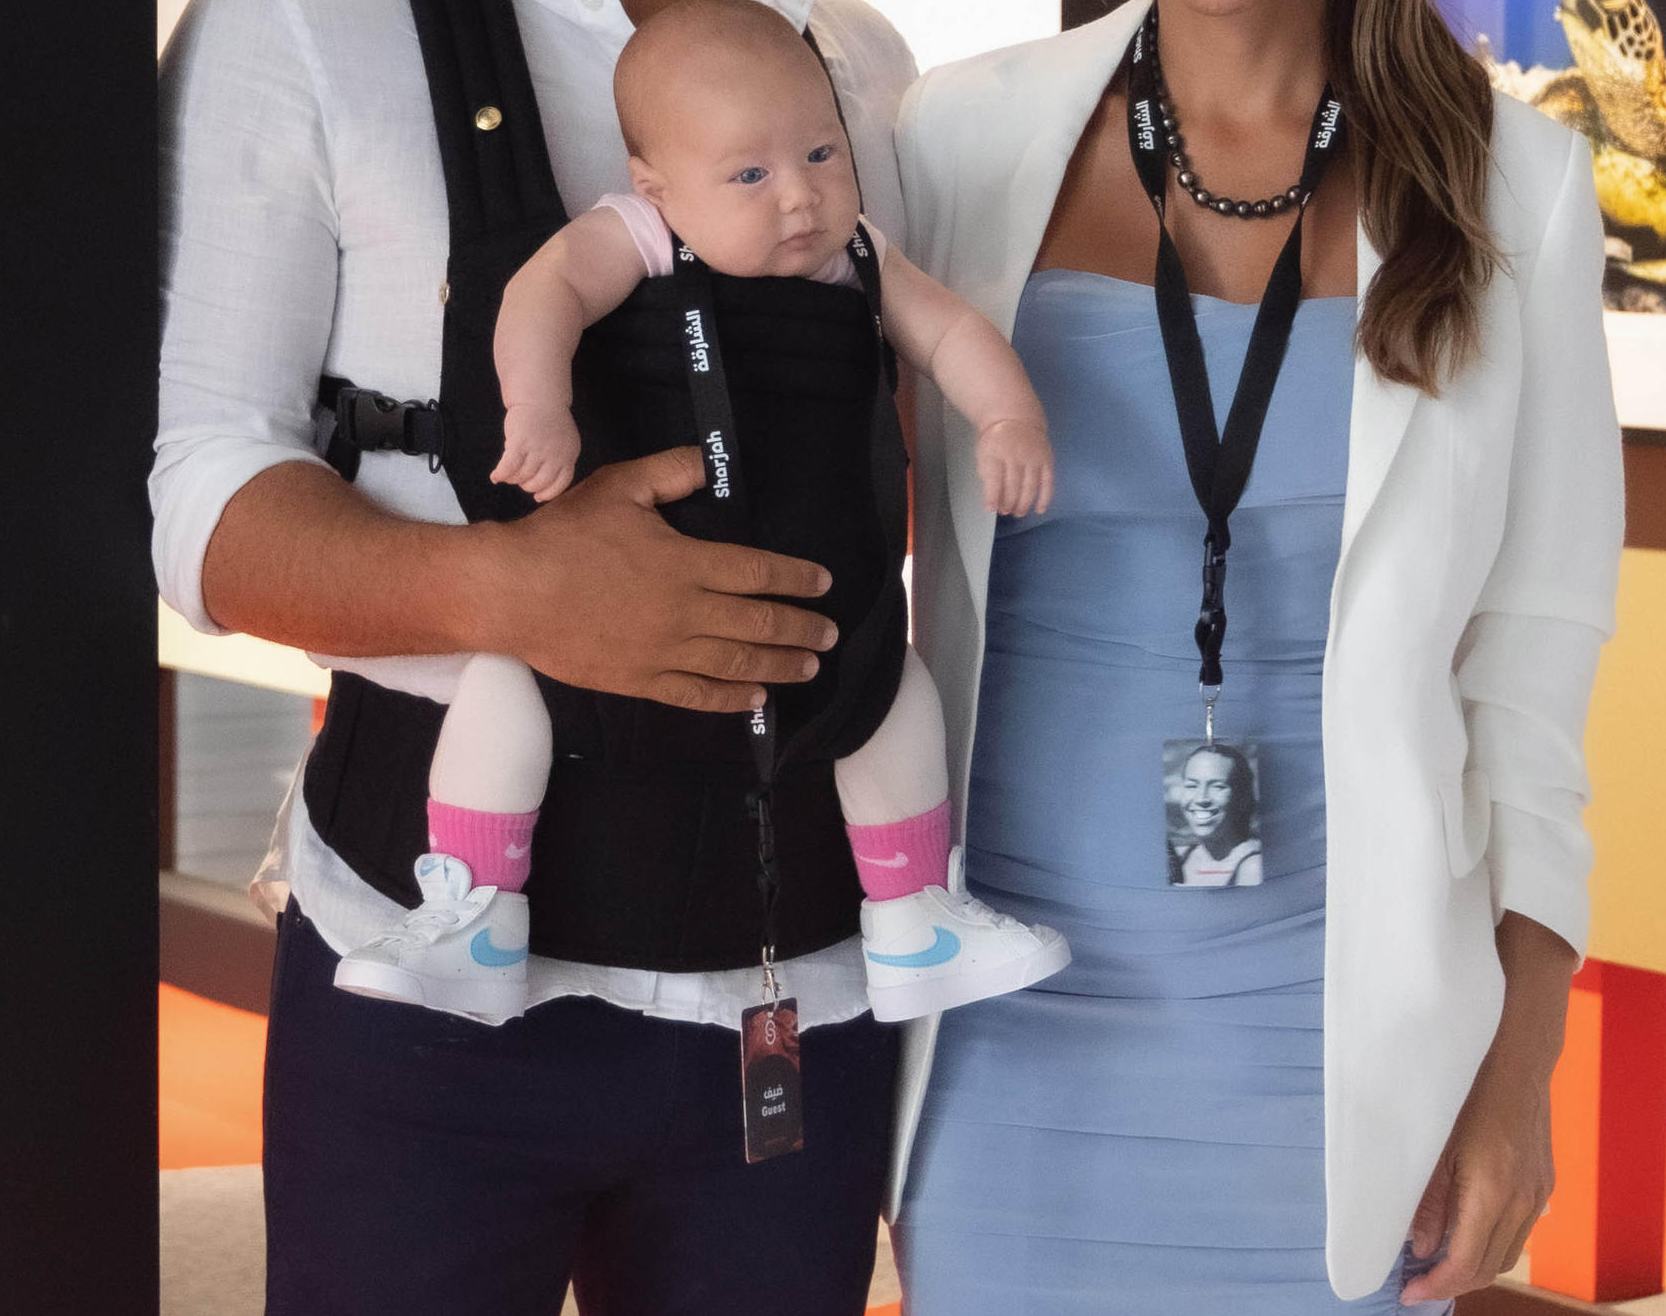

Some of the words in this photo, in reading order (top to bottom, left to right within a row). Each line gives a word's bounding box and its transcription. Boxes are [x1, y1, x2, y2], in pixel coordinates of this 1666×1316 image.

[1134, 99, 1155, 150] الشارقة
[1314, 100, 1341, 148] الشارقة
[685, 309, 710, 373] الشارقة
[706, 430, 730, 498] Sharjah
[761, 1102, 786, 1118] Guest
